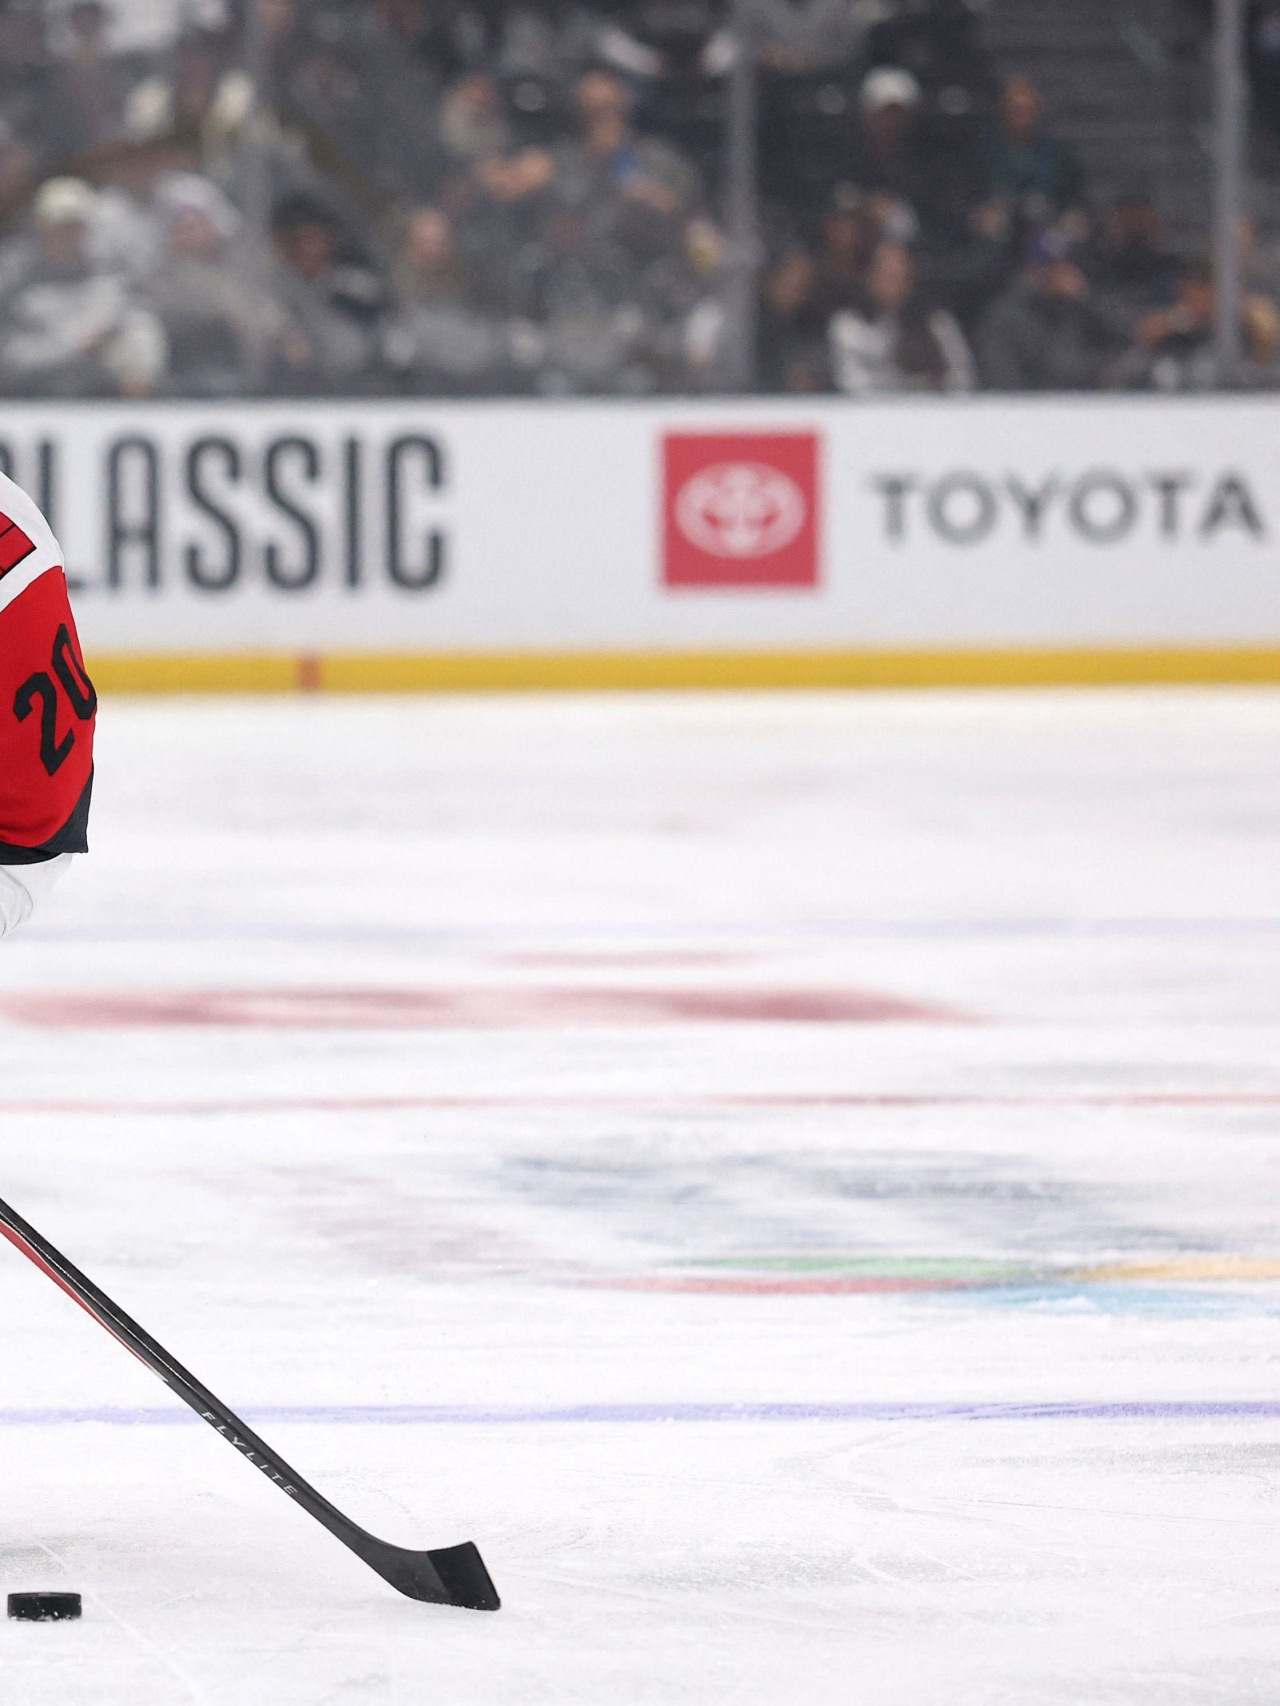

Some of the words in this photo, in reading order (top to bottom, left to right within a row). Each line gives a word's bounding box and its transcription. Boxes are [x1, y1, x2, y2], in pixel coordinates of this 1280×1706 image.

[870, 466, 1266, 546] TOYOTA
[12, 623, 98, 777] 20
[202, 1411, 298, 1495] FLYLITE
